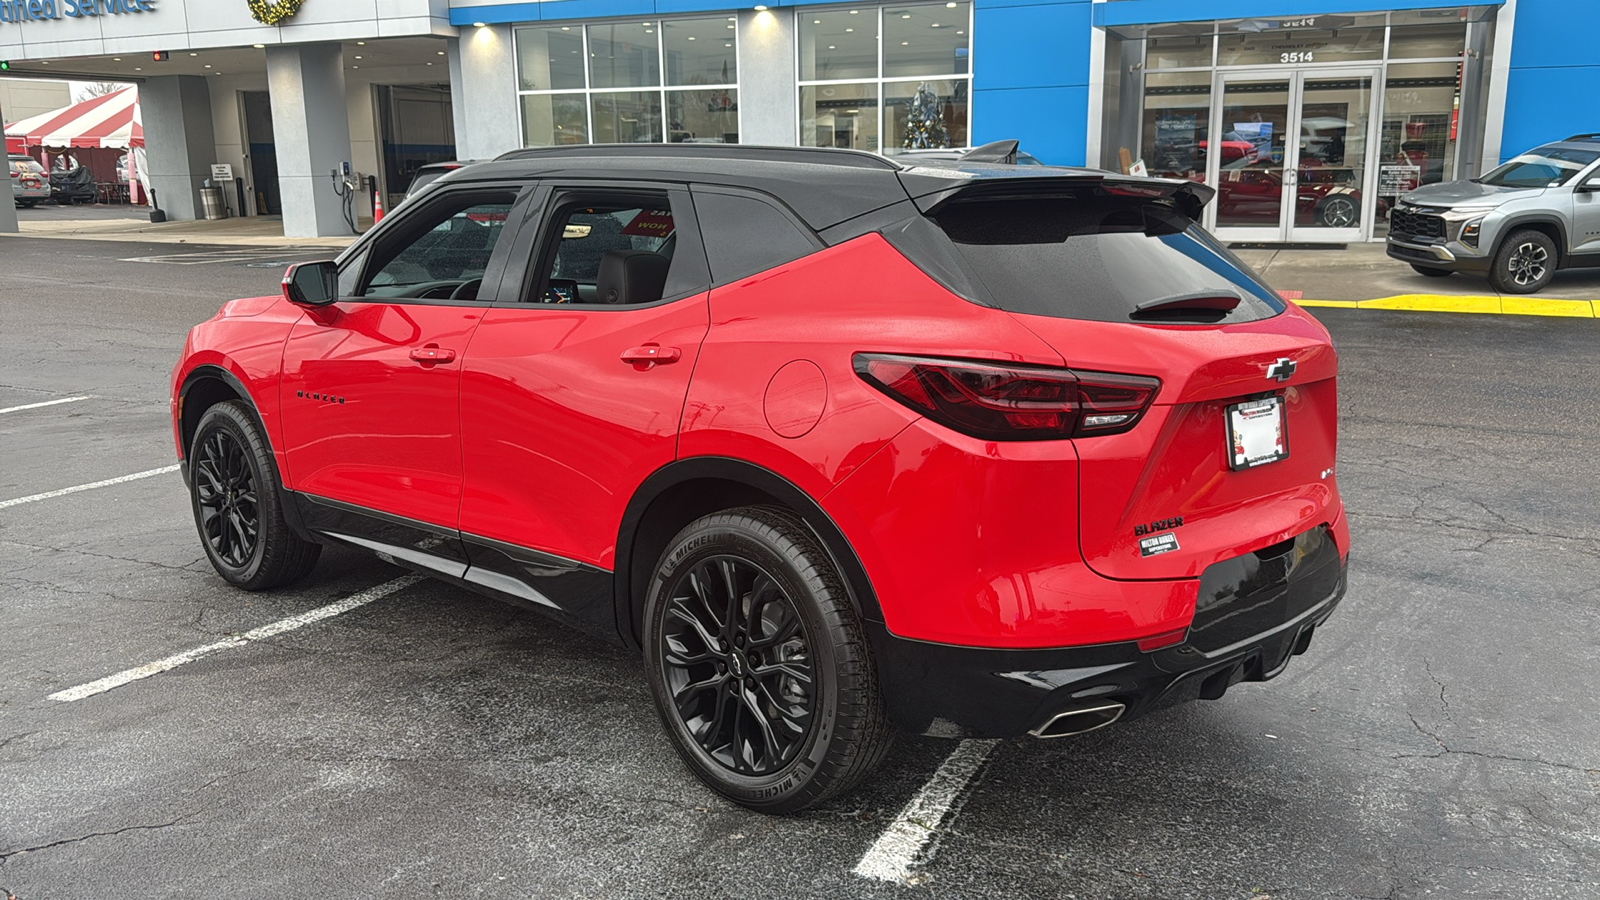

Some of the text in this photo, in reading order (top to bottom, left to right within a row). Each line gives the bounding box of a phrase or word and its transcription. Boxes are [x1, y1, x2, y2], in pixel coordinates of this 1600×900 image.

[1280, 52, 1314, 63] 3514
[297, 389, 345, 404] BLAZER
[1134, 516, 1183, 536] BLAZER
[676, 533, 726, 559] MICHELIN
[742, 778, 793, 797] MICHELIN
